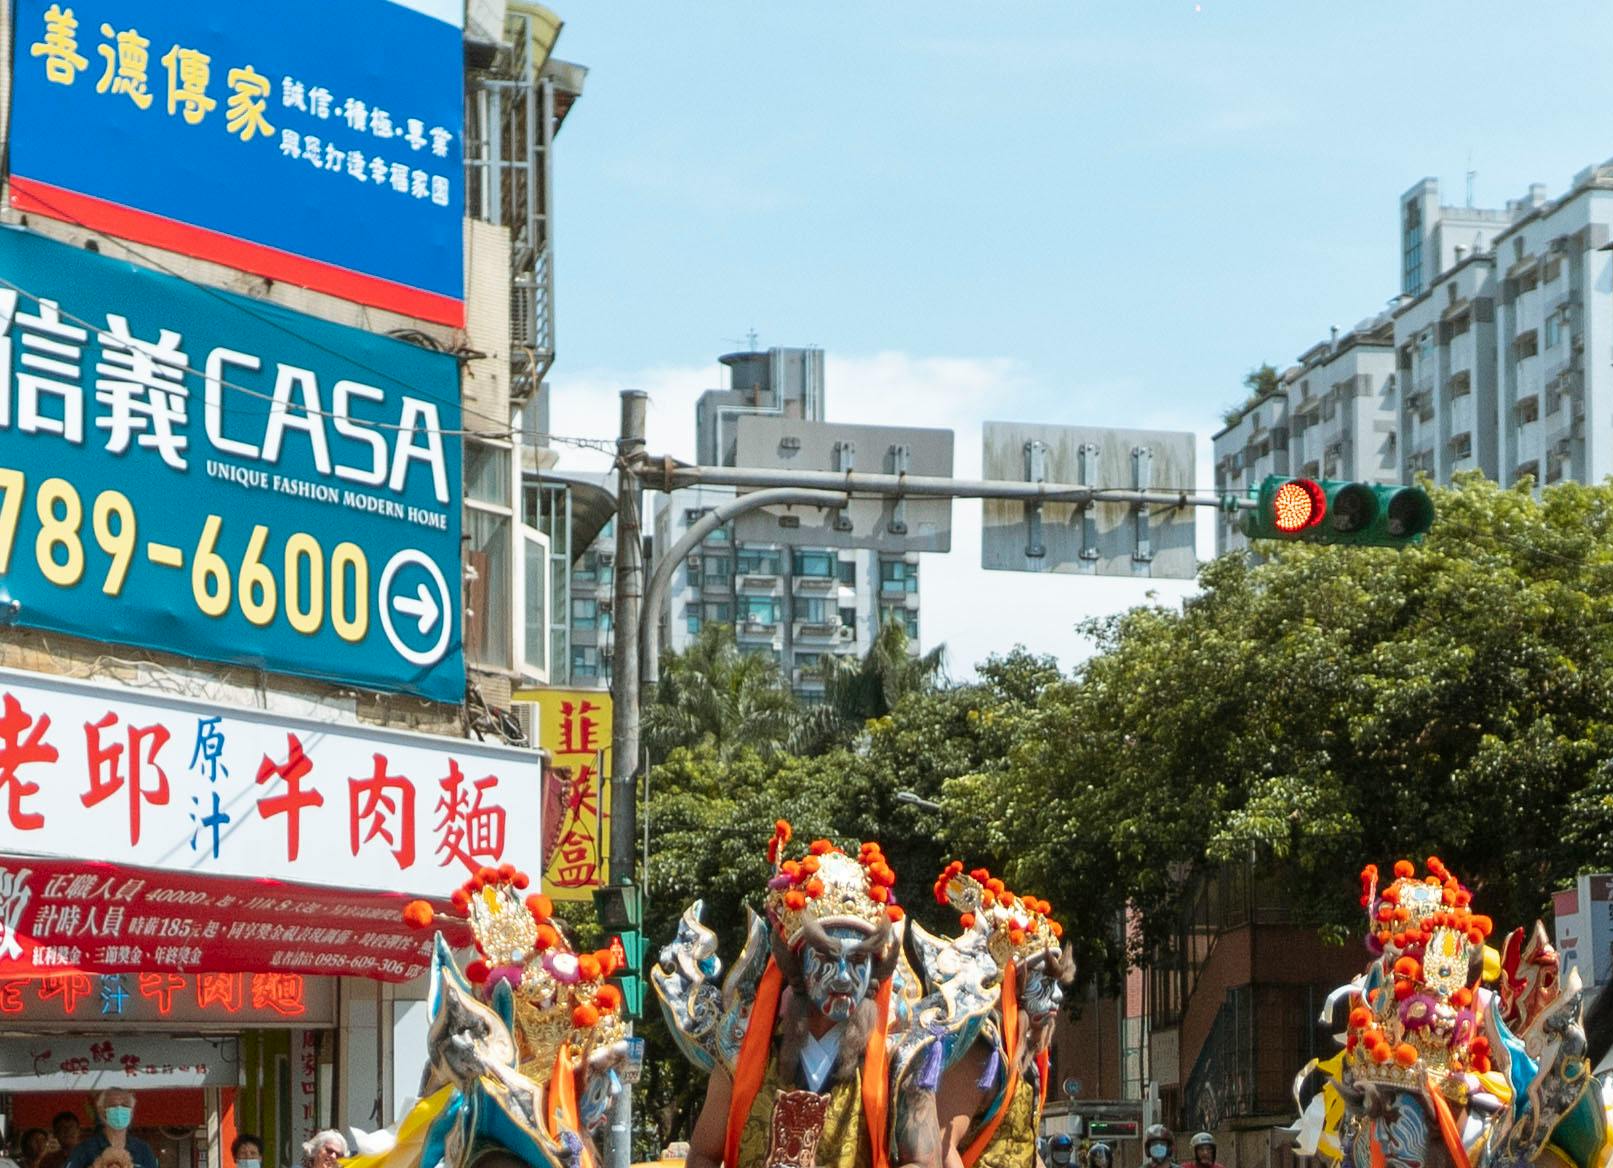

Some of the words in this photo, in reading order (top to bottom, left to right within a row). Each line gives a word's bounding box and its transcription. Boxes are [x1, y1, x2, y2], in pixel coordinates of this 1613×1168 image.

[206, 460, 269, 490] UNIQUE
[273, 474, 339, 505] FASHION
[343, 491, 404, 520] MODERN
[408, 506, 448, 530] HOME
[188, 715, 231, 860] 原汁
[255, 732, 508, 875] 牛肉麵
[42, 873, 146, 902] 正職人員
[32, 906, 126, 938] 計時人員
[314, 953, 404, 974] 0958-609-306
